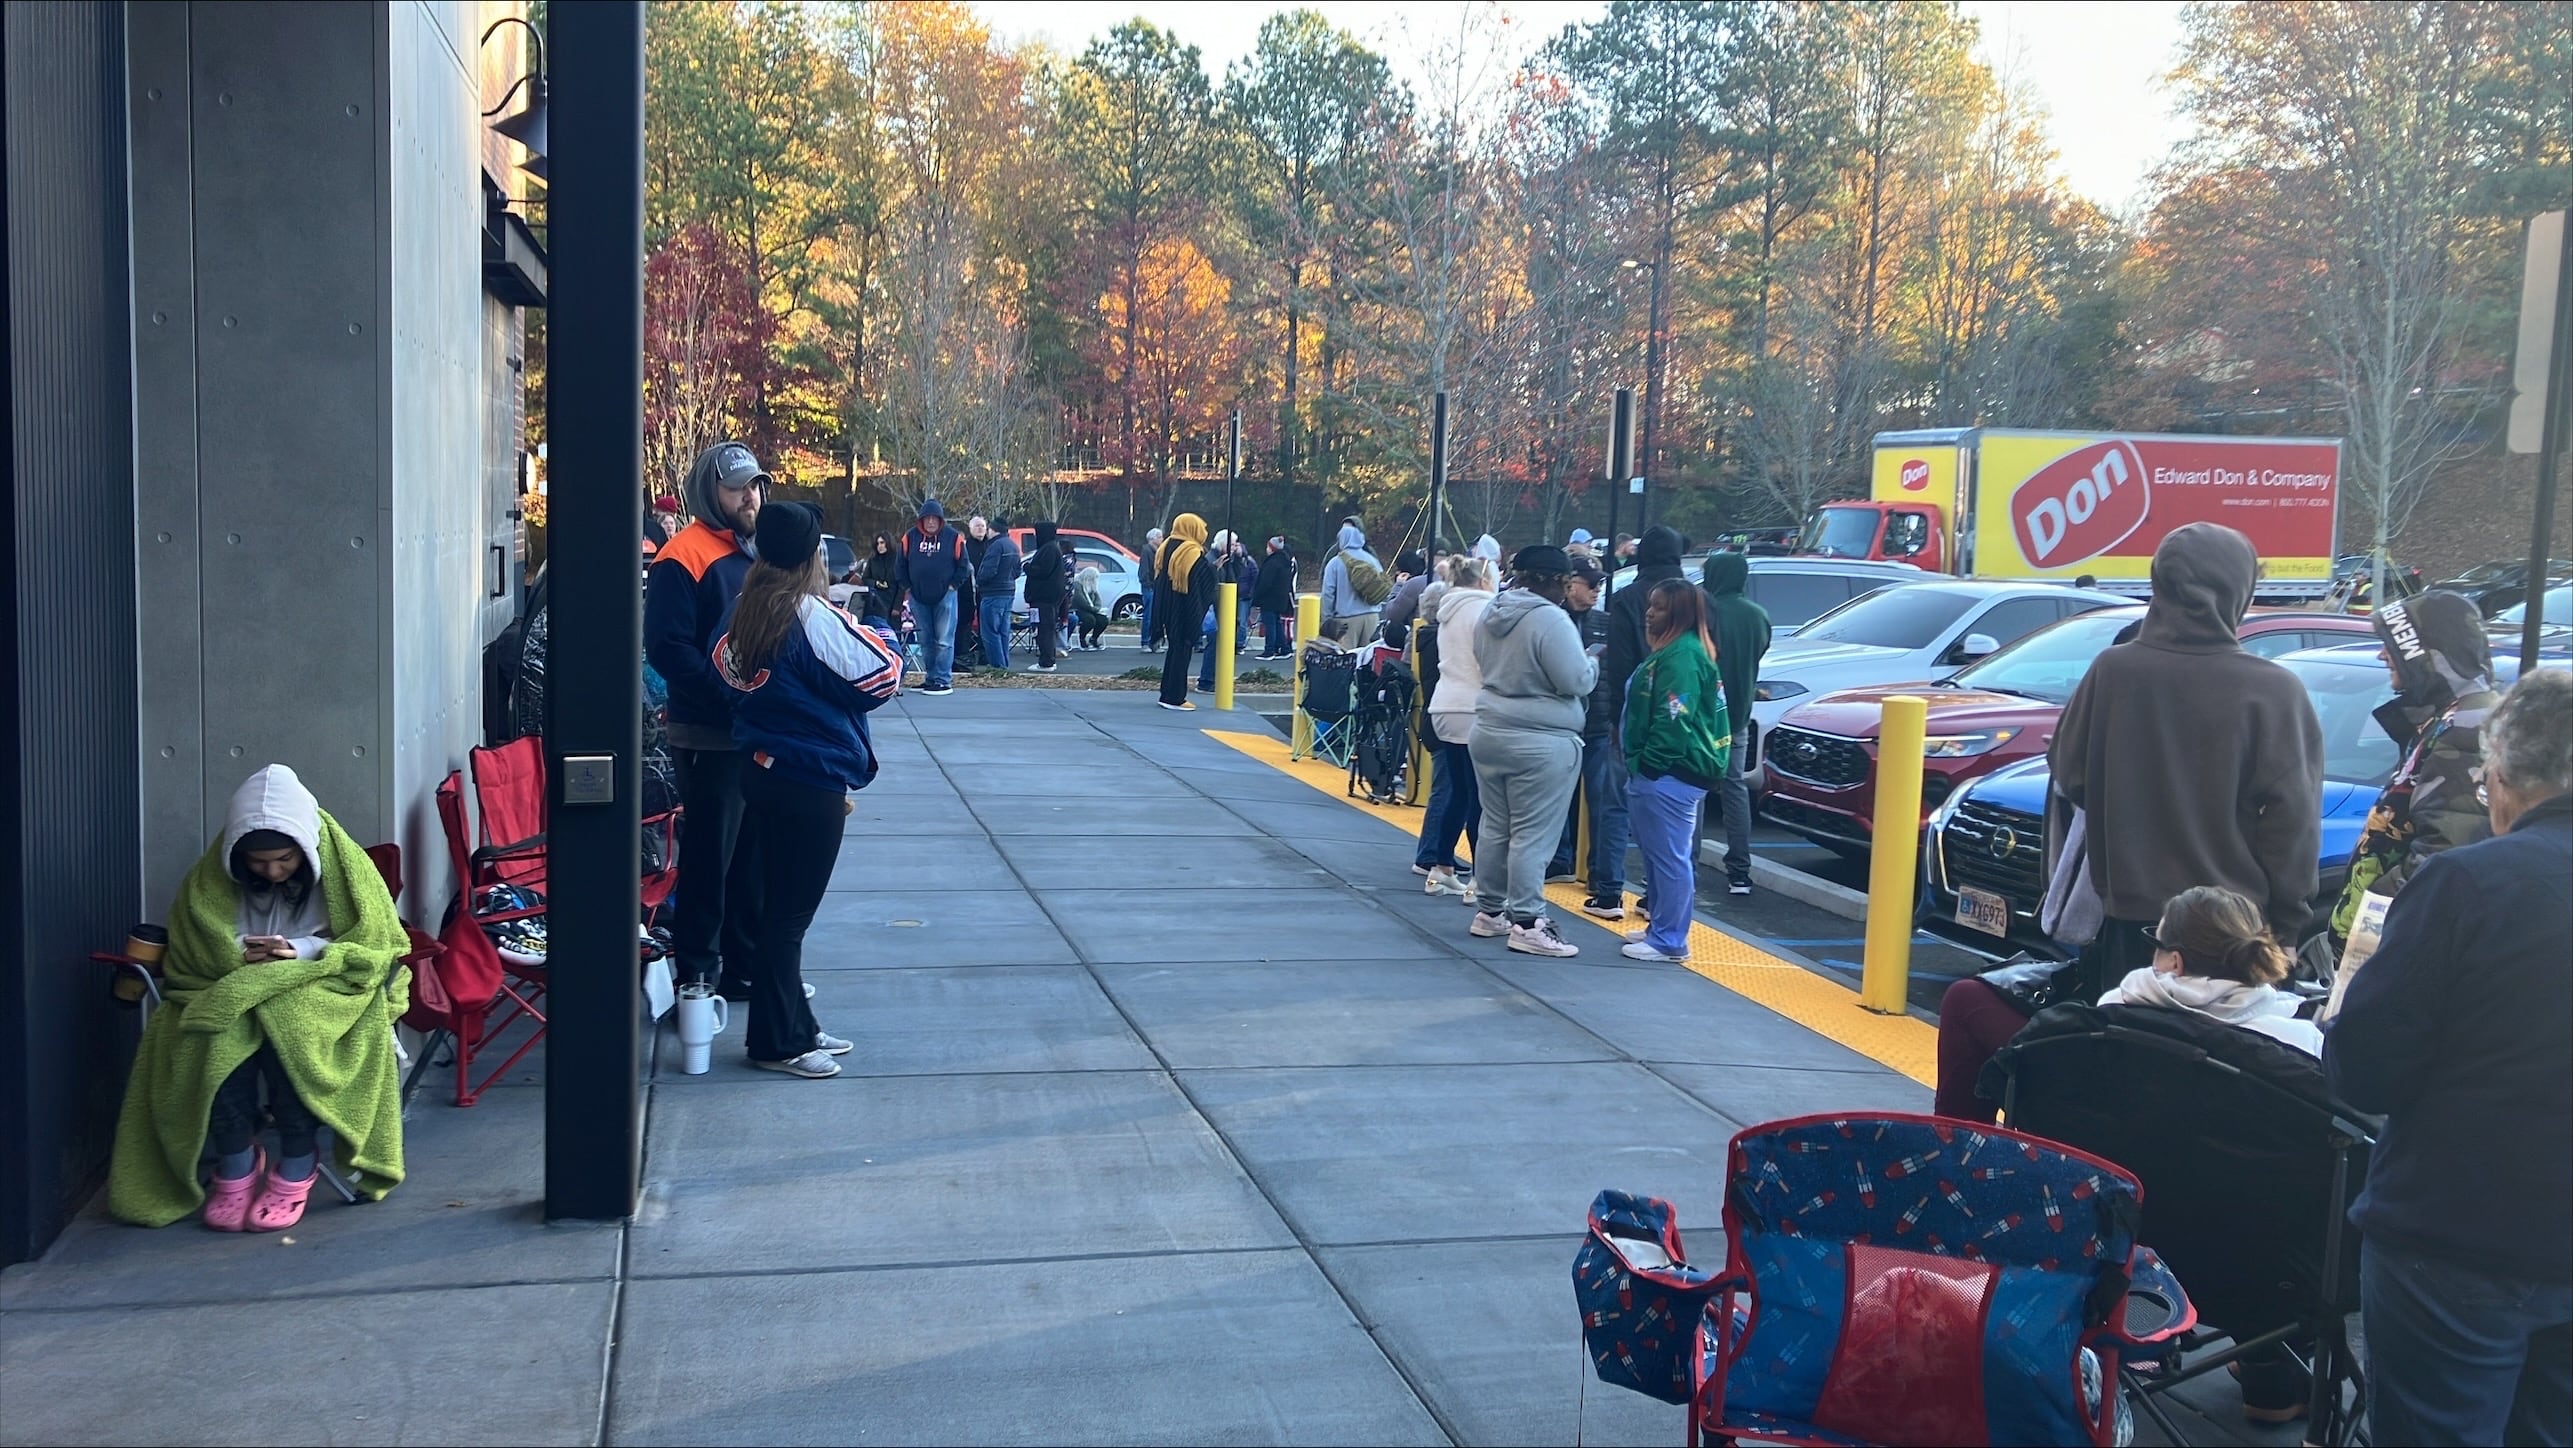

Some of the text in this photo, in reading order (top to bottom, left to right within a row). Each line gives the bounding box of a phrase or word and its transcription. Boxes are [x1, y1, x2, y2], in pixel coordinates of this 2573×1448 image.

[1903, 463, 1928, 486] Don
[2154, 467, 2331, 490] Edward Don & Company
[2026, 448, 2129, 561] Don
